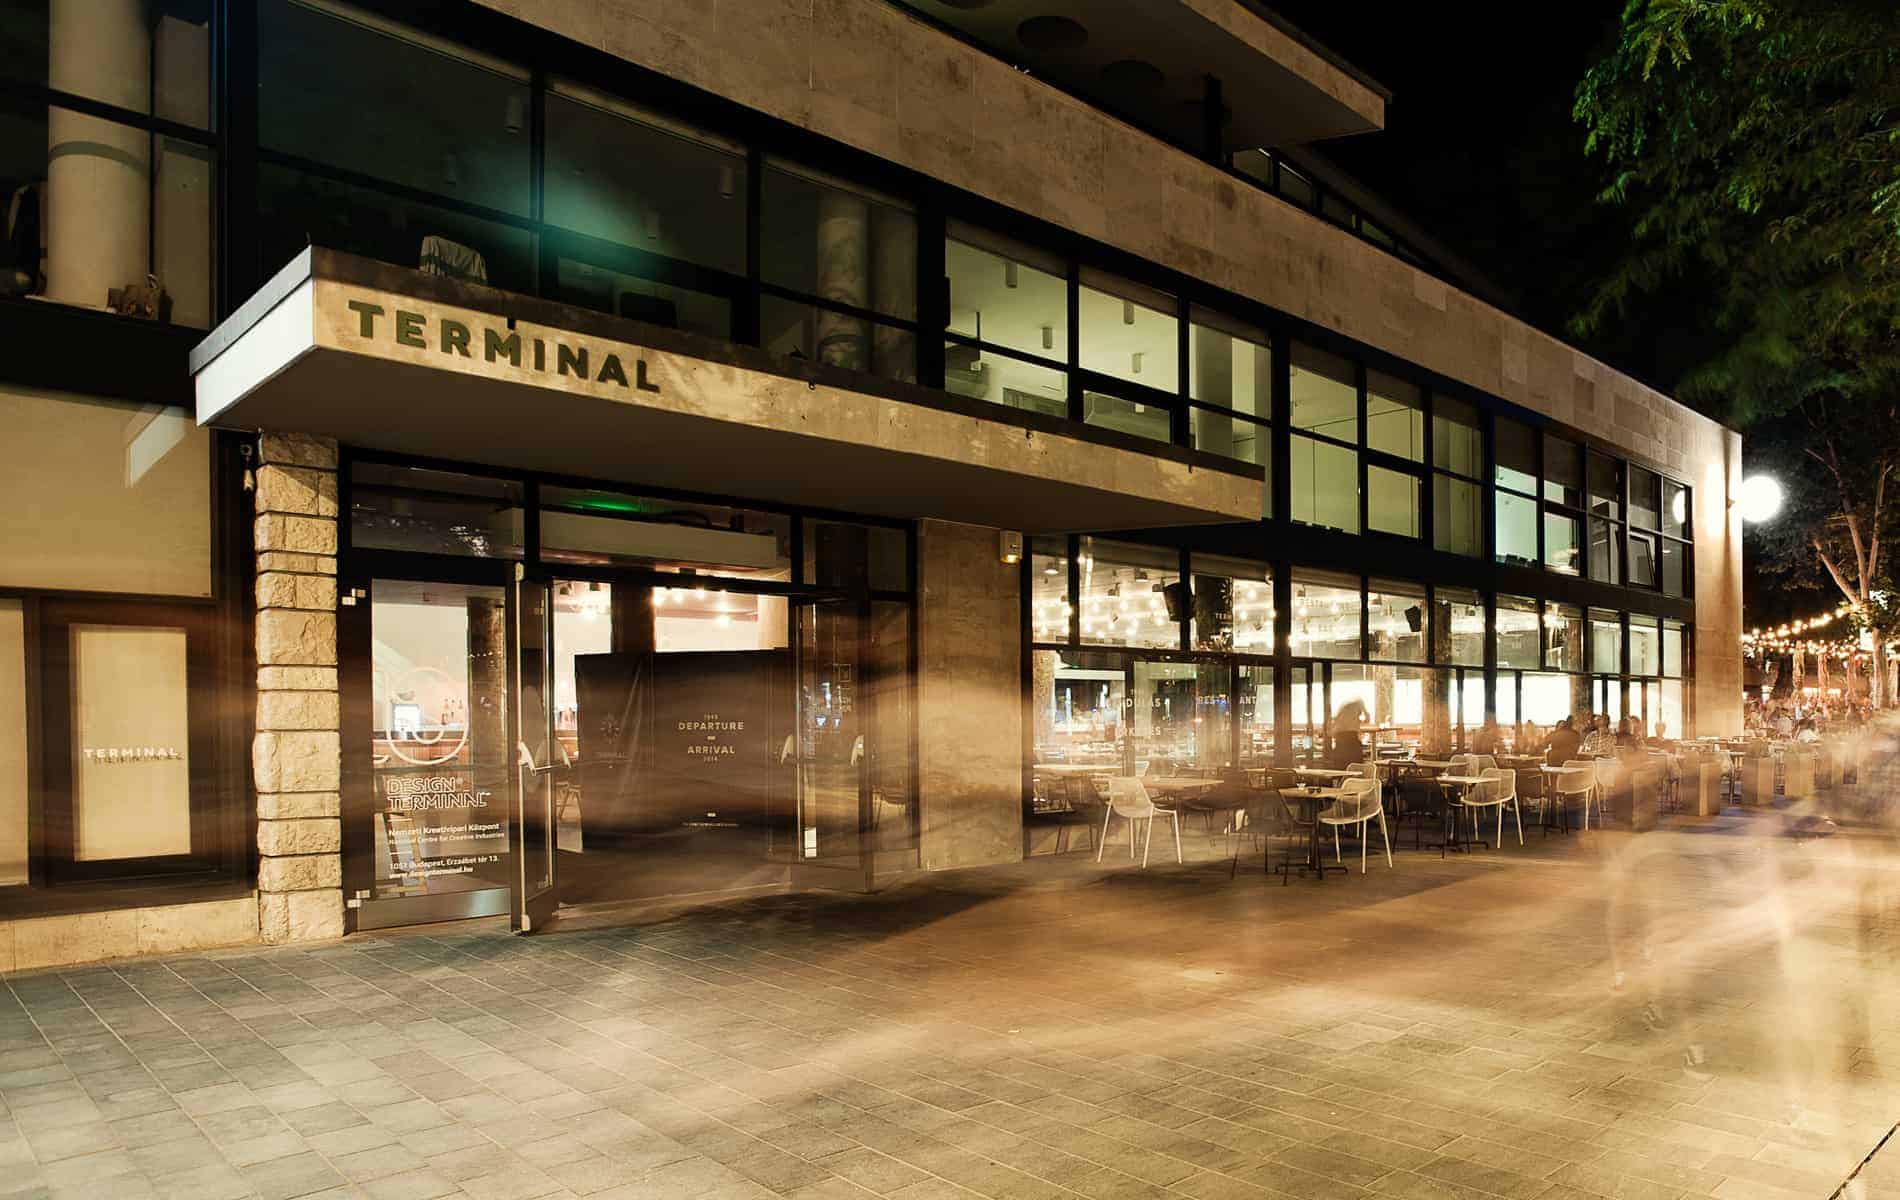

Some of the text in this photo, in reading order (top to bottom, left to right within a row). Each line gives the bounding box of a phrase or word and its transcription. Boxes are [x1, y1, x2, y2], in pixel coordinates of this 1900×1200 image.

[348, 299, 661, 394] TERMINAL
[678, 721, 745, 731] DEPARTURE
[83, 747, 178, 759] TERMINAL
[687, 745, 736, 754] ARRIVAL
[387, 776, 456, 796] DESIGN
